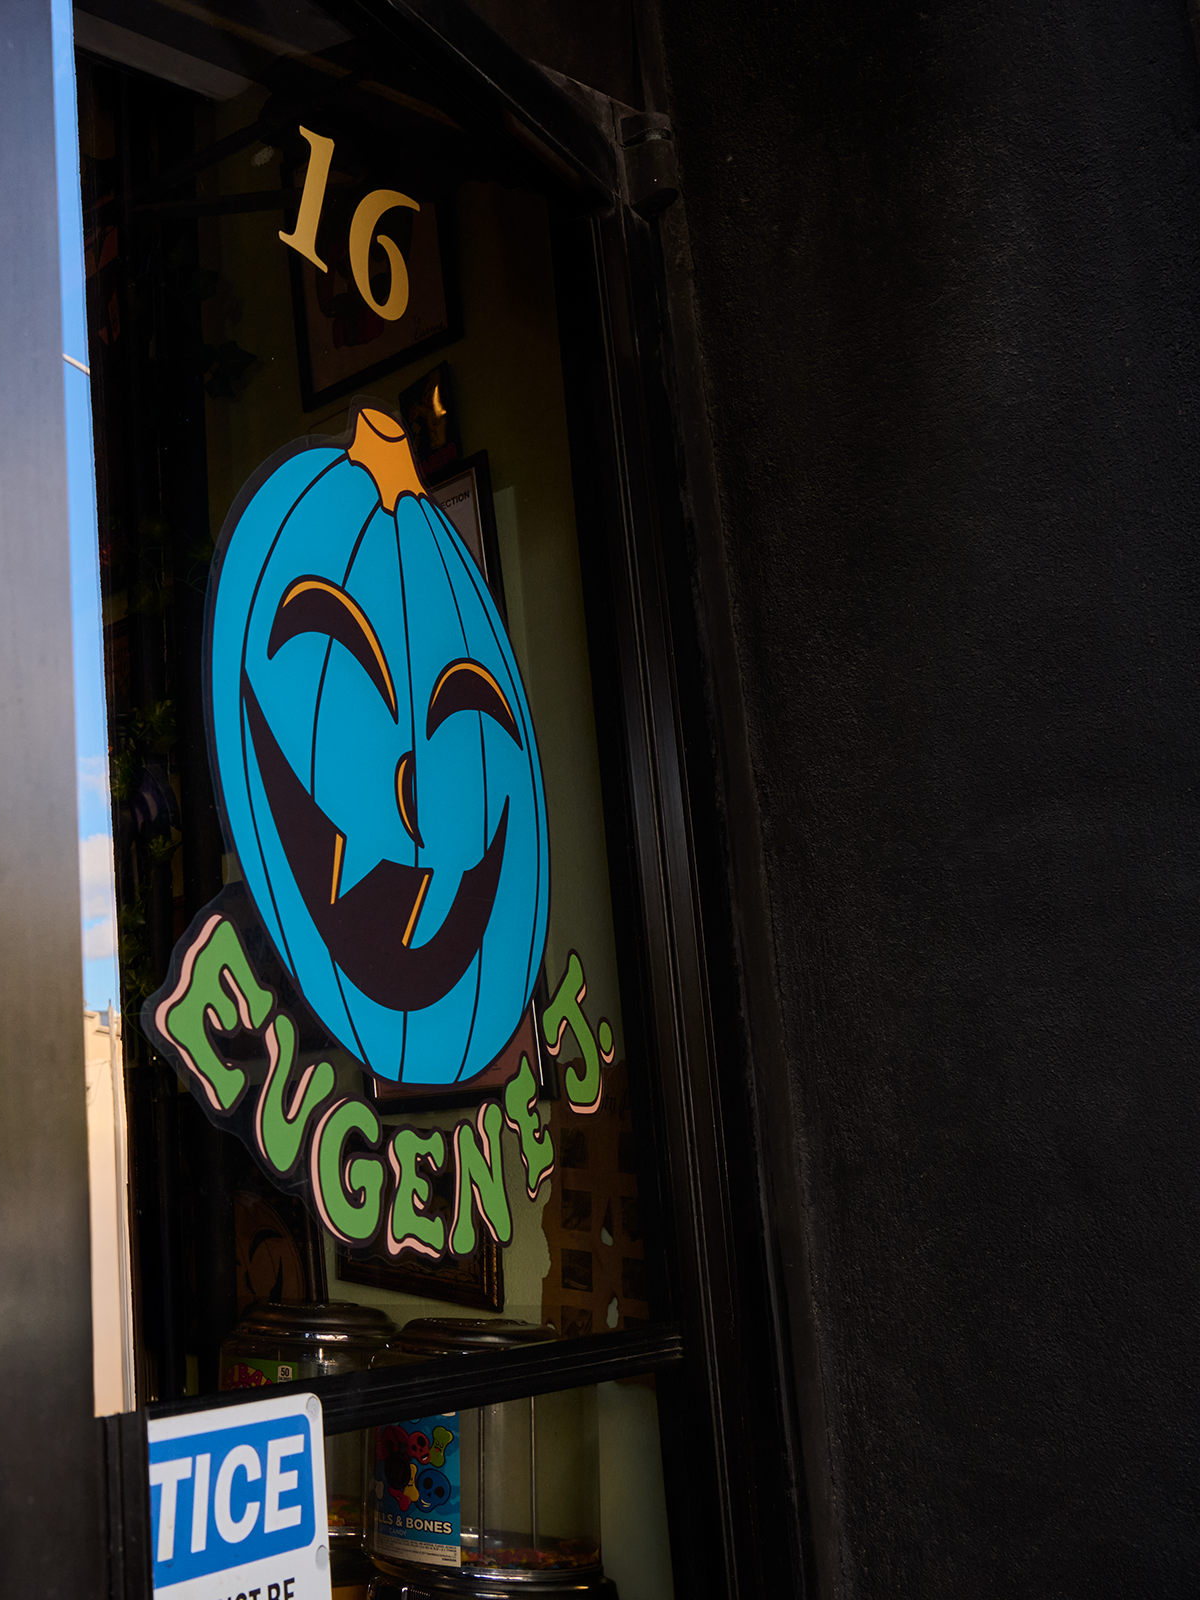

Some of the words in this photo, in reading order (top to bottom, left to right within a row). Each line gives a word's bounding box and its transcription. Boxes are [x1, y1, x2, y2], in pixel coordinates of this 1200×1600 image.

[278, 125, 421, 321] 16
[154, 913, 555, 1260] EUGENE
[375, 1510, 394, 1526] LLS
[405, 1516, 453, 1535] BONES
[388, 1527, 408, 1537] CANDY
